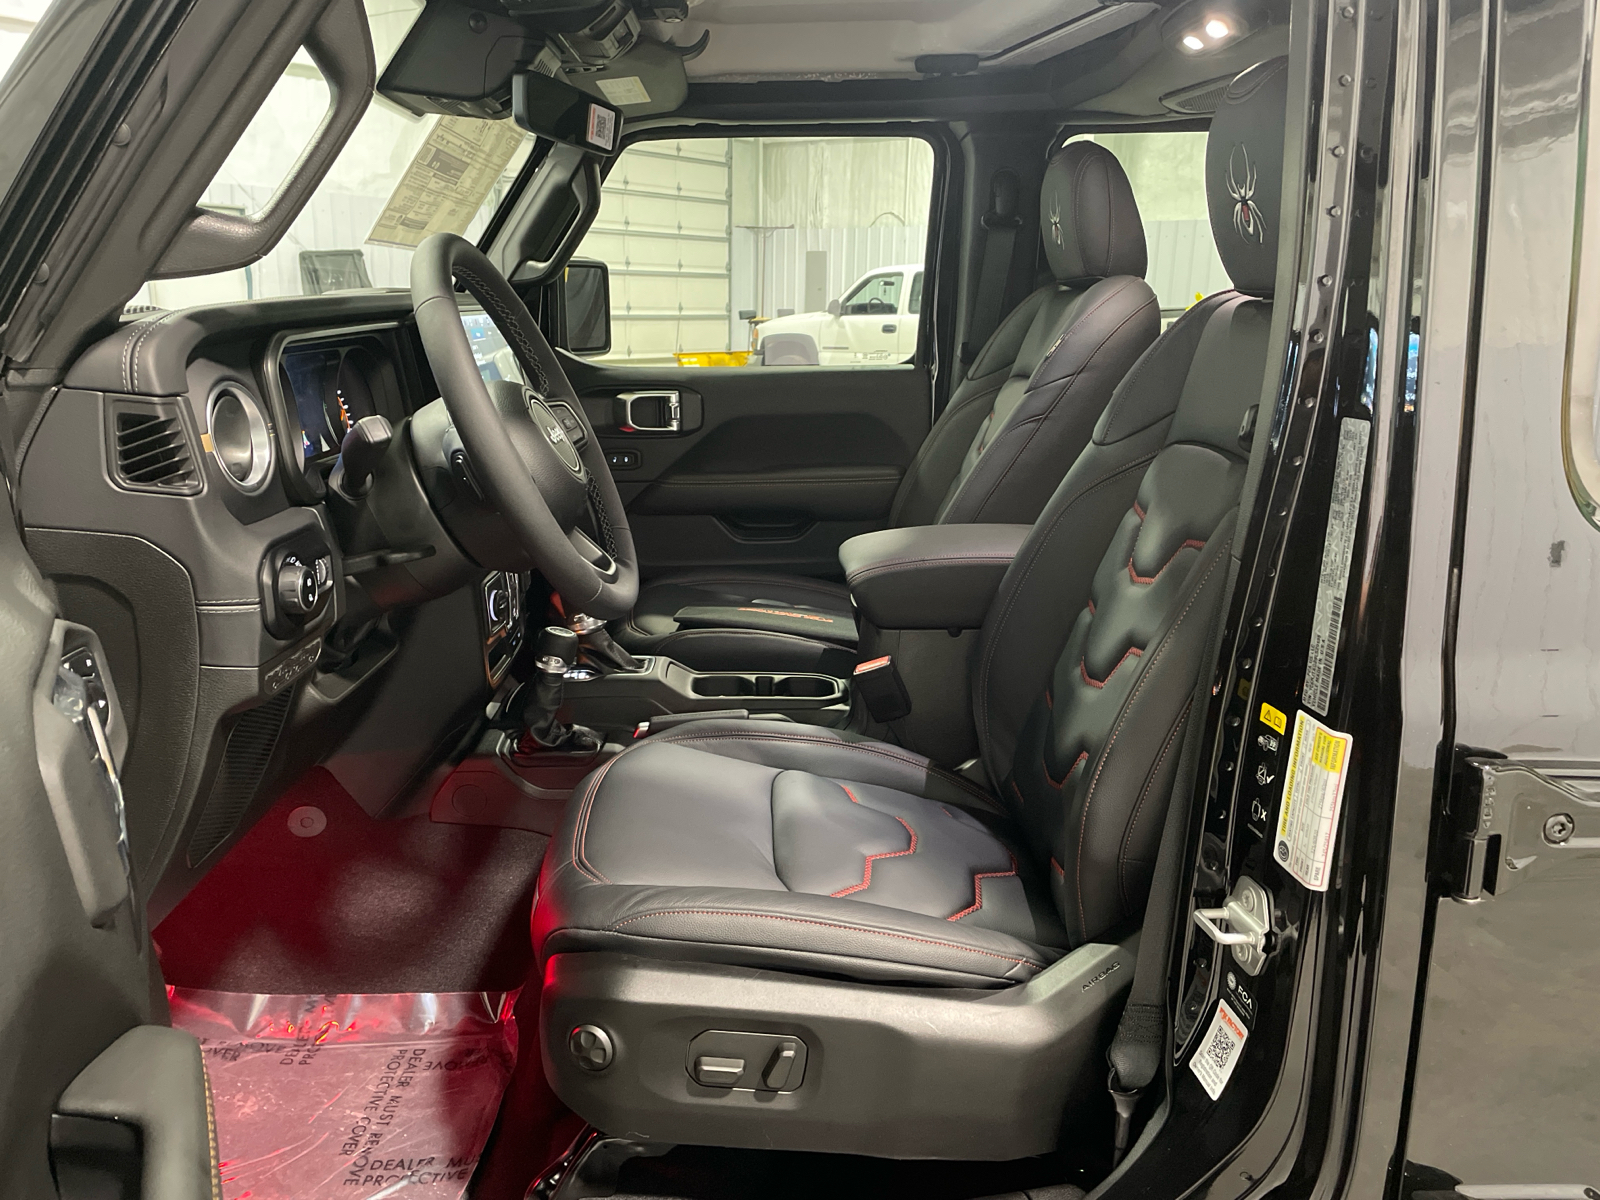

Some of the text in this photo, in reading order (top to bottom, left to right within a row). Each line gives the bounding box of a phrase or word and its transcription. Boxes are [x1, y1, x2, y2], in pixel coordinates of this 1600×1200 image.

[1286, 769, 1295, 800] LOADING
[1291, 718, 1303, 768] INFORMATION
[1313, 864, 1321, 882] SPARE
[1081, 961, 1120, 993] AIRBAG
[1238, 985, 1252, 1009] FCA
[396, 1048, 426, 1088] DEALER
[339, 1049, 408, 1156] PROTECTIVE COVER
[376, 1095, 402, 1126] MUST
[362, 1168, 469, 1186] PROECTIVE
